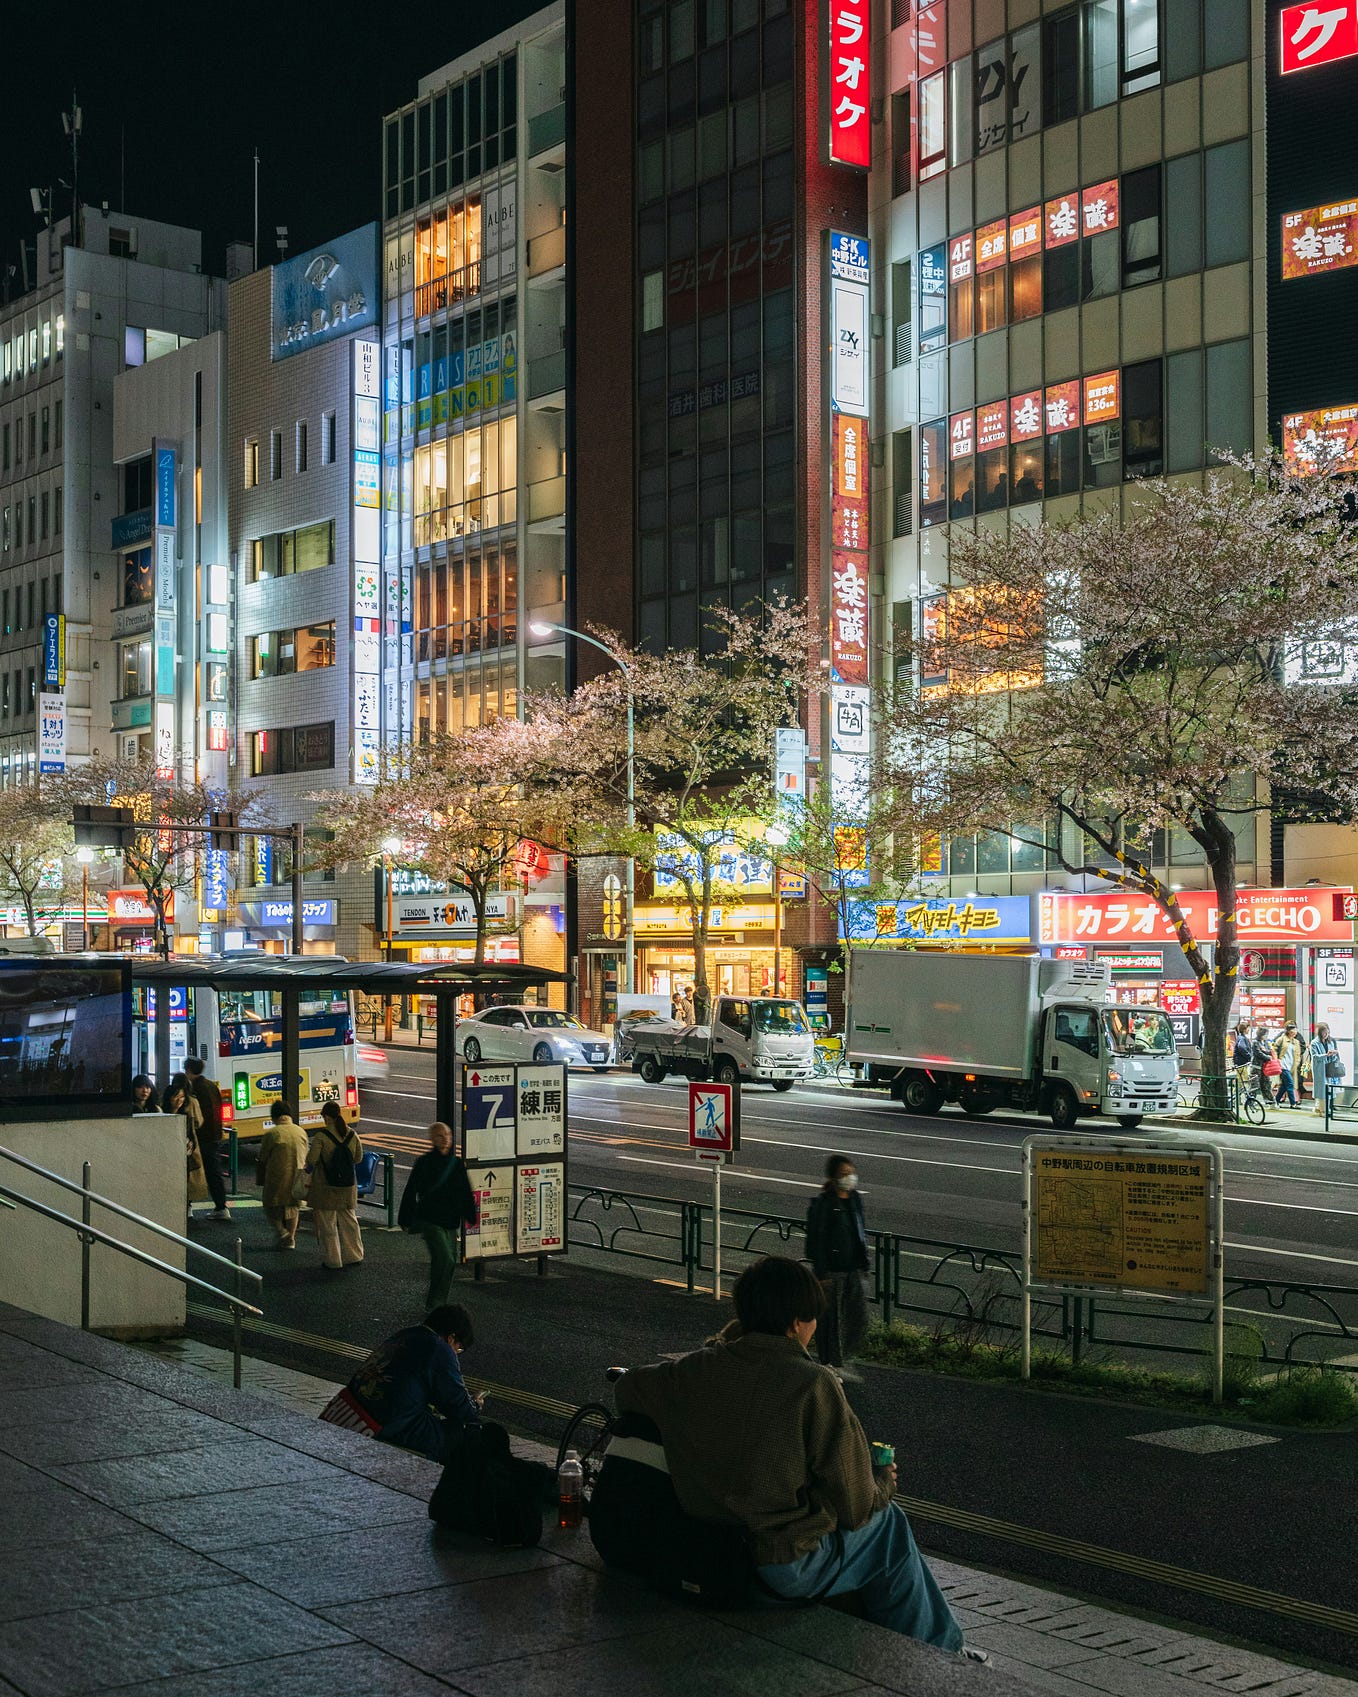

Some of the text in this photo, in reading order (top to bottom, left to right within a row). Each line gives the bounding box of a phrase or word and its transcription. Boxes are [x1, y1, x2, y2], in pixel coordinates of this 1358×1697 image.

[835, 0, 866, 128] ラオケ
[1286, 214, 1302, 228] 5F
[831, 247, 867, 268] 中野ビル
[952, 239, 971, 262] 4F
[1308, 257, 1333, 267] RAKUZO
[954, 264, 968, 277] 受付
[840, 328, 859, 350] ZXY
[668, 371, 760, 415] 酒井歯科医院
[953, 418, 972, 439] 4F
[1286, 416, 1303, 428] 4F
[980, 431, 1006, 444] RAKUZO
[844, 427, 857, 491] 全席個室
[833, 562, 866, 649] 楽蔵
[125, 612, 147, 626] Premier
[845, 689, 857, 699] 3F
[42, 718, 63, 730] 1対1
[42, 730, 63, 739] ネッツ
[159, 770, 172, 779] 2F
[1251, 895, 1309, 904] Entertainment
[403, 908, 427, 917] TENDON
[485, 904, 498, 914] NYA
[906, 902, 1001, 937] マツモトキヨシ
[1043, 897, 1053, 941] カラオケ
[1254, 905, 1321, 933] ECHO
[1059, 948, 1085, 958] カラオケ
[1319, 949, 1332, 957] 3F
[322, 1069, 338, 1078] 341
[520, 1090, 562, 1116] 練馬
[481, 1094, 504, 1130] 7
[1041, 1157, 1201, 1177] 中野駅周辺の自転車放置規制区域
[1125, 1226, 1152, 1234] CAUTION
